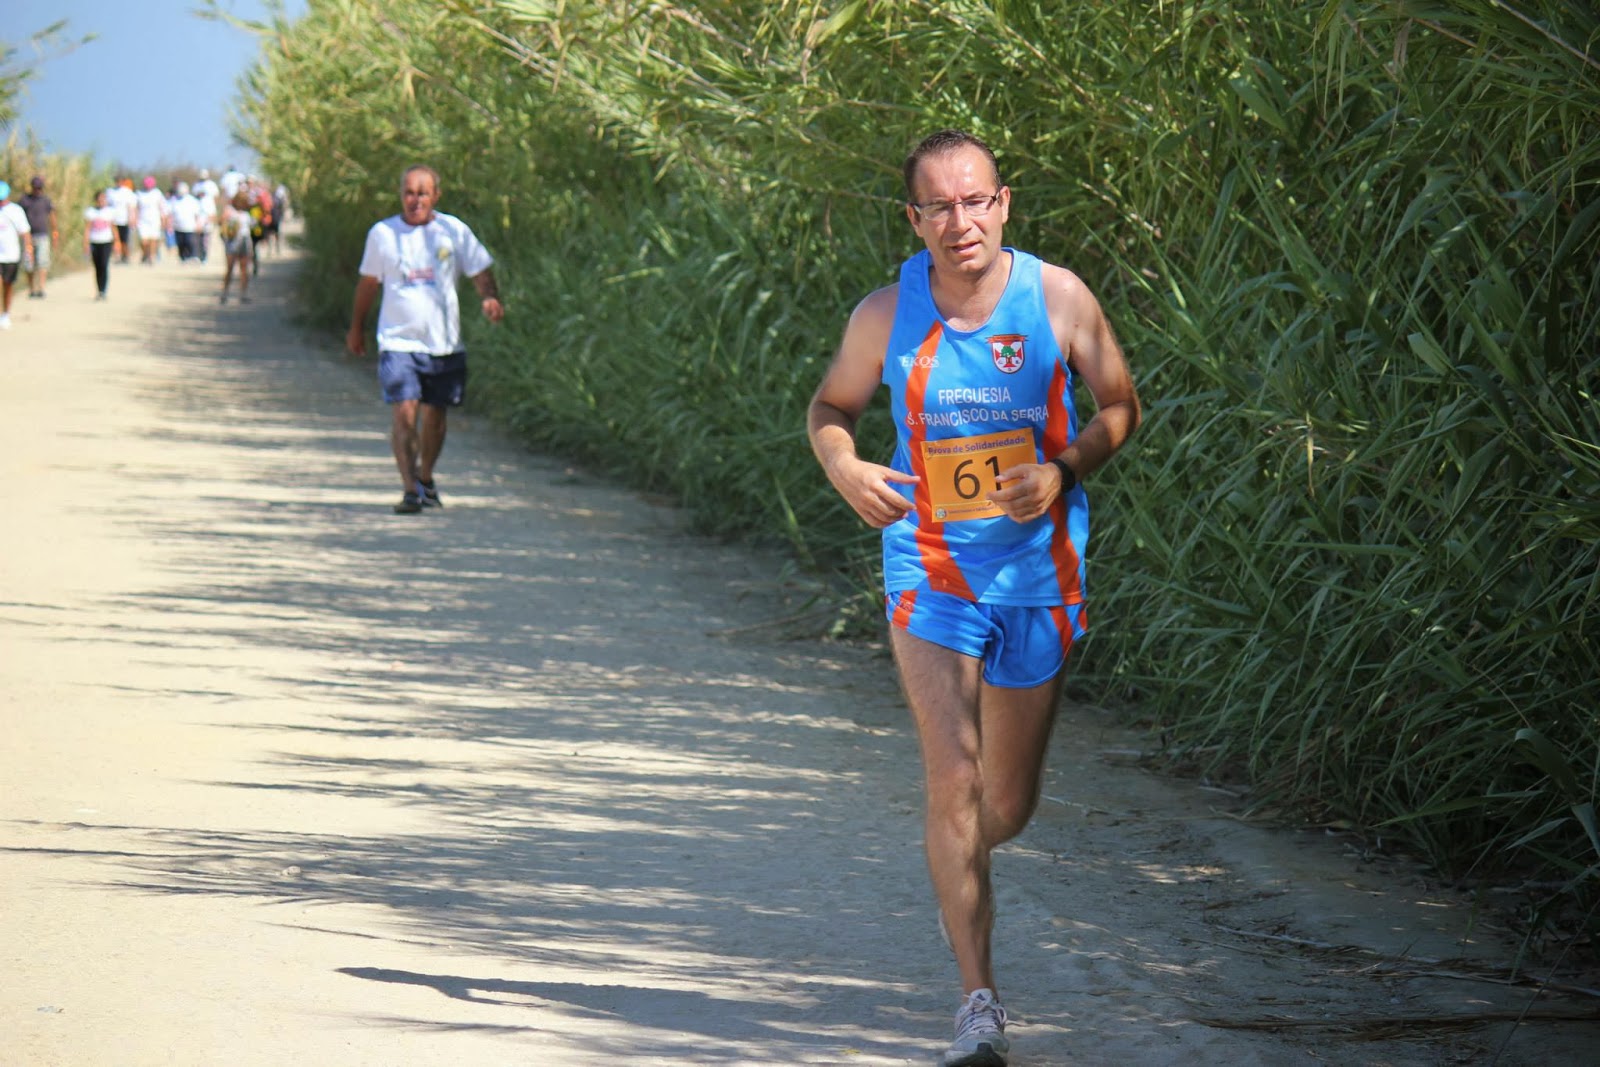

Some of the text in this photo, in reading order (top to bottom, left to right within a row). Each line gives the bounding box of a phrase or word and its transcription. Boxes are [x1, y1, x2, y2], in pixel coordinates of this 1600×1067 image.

[938, 386, 1011, 405] FREGUESIA
[907, 405, 1050, 427] S. FRANCISCO DA SERRA
[928, 437, 1026, 455] Prova de Solidariedade
[953, 456, 1003, 500] 61
